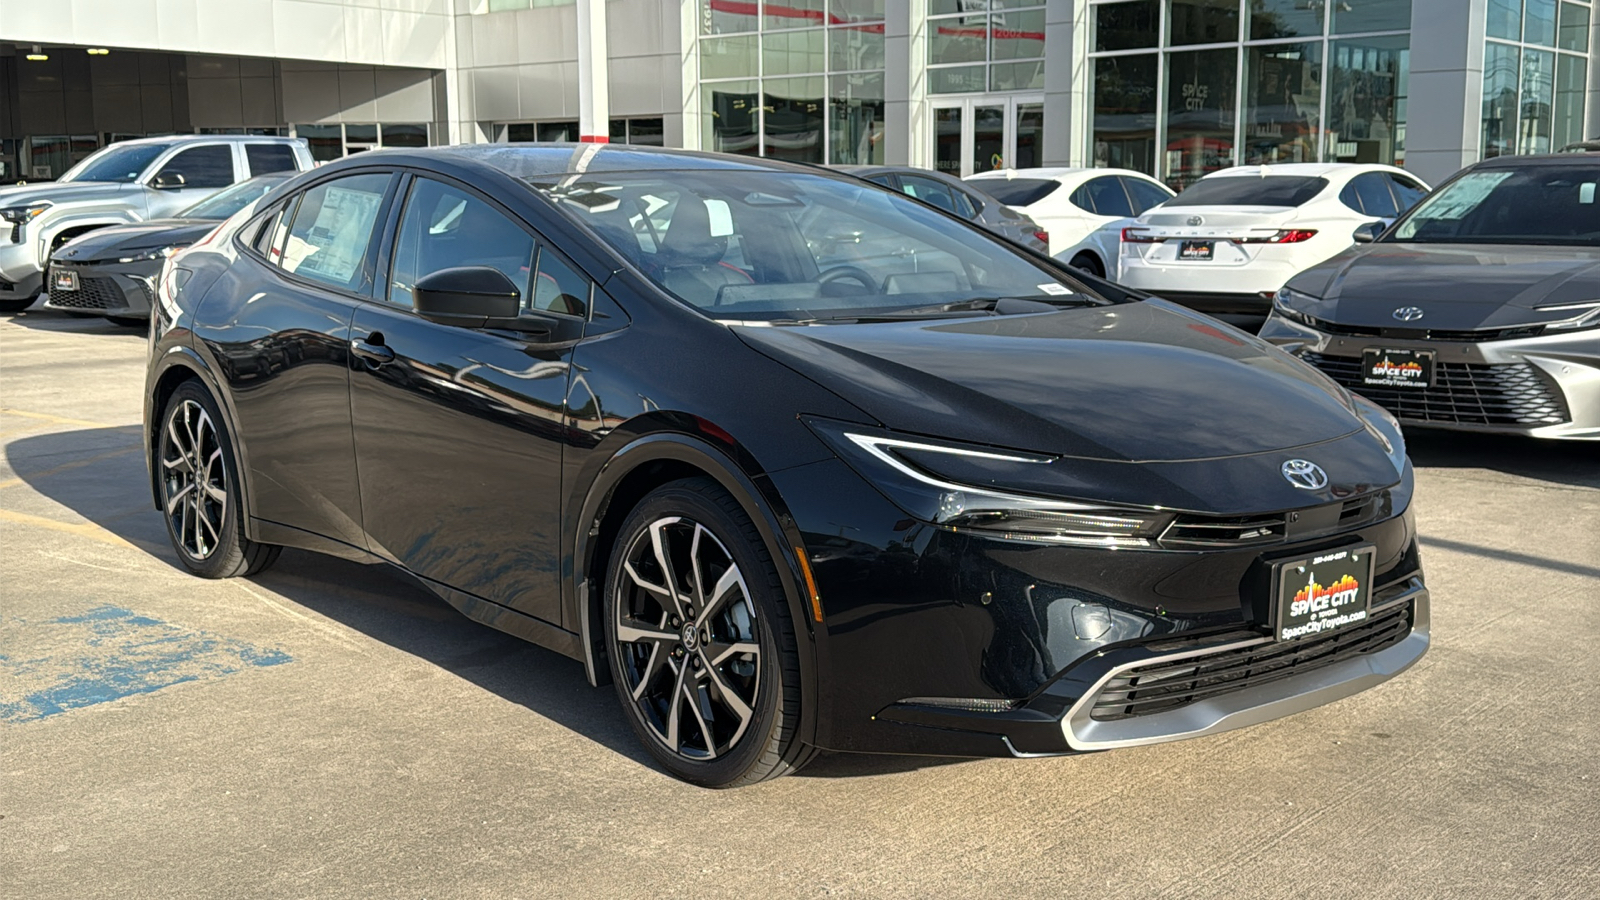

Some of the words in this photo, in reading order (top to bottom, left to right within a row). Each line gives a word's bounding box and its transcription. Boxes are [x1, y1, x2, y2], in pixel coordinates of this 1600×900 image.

[1182, 79, 1208, 98] SPACE
[1186, 97, 1205, 110] CITY
[1372, 364, 1400, 376] SPACE
[1402, 369, 1422, 377] CITY
[1290, 592, 1330, 617] SPACE
[1331, 588, 1358, 606] CITY
[1281, 611, 1366, 639] SpaceCityToyota.com
